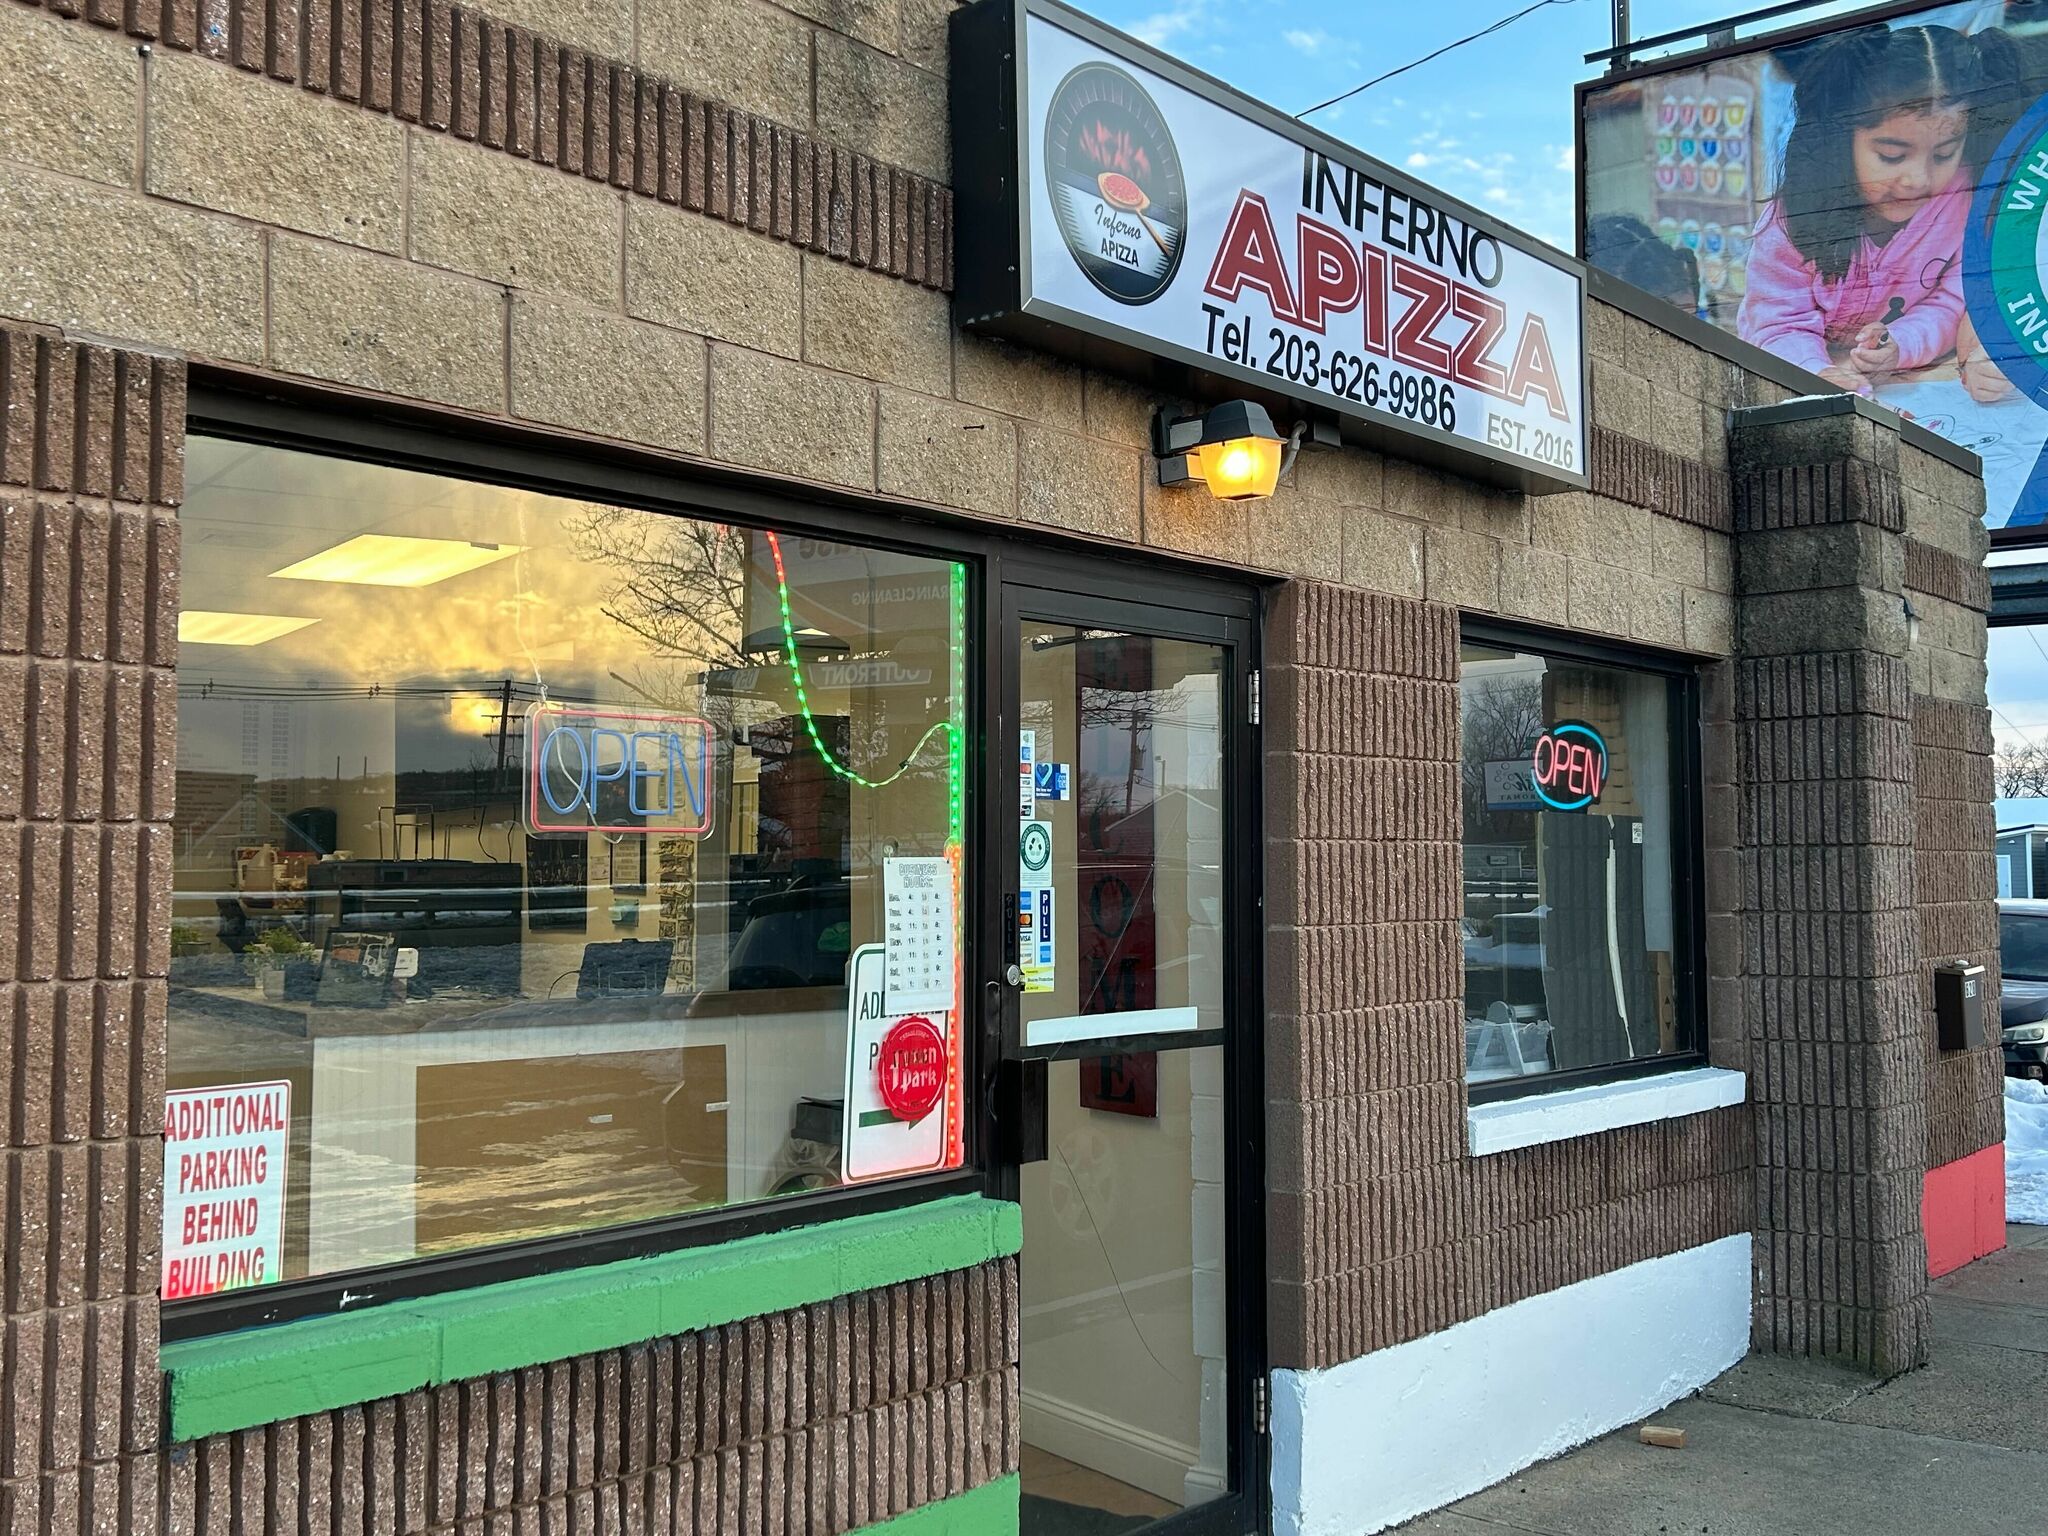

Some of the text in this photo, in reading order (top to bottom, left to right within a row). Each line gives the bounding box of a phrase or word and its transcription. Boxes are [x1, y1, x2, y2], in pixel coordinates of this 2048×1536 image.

[1094, 203, 1142, 240] Inferno
[1302, 146, 1504, 289] INFERNO
[1101, 237, 1140, 268] APIZZA
[1204, 187, 1571, 424] APIZZA
[1201, 303, 1456, 433] Tel. 203-626-9986
[1487, 412, 1574, 469] EST. 2016
[540, 726, 704, 817] OPEN
[1535, 734, 1601, 798] OPEN
[164, 1092, 284, 1143] ADDITIONAL
[179, 1145, 267, 1194] PARKING
[182, 1197, 258, 1246] BEHIND
[167, 1247, 265, 1298] BUILDING
